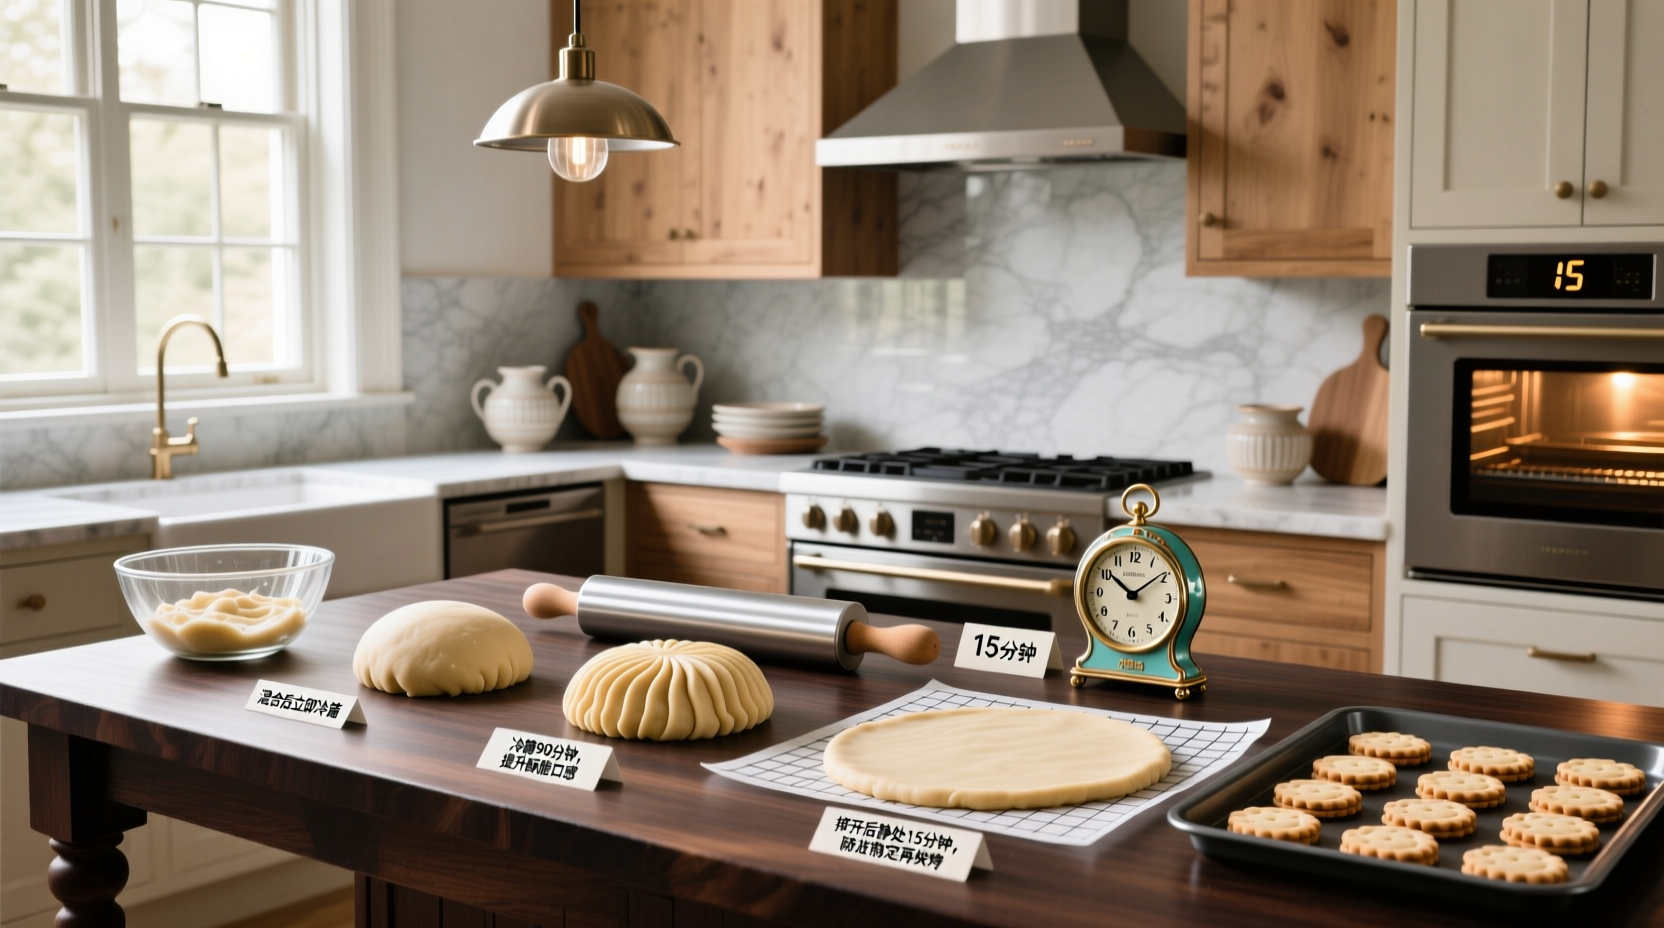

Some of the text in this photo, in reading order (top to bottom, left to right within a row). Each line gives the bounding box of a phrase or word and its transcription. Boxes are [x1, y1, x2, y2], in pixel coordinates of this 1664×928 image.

[1554, 259, 1585, 291] 15
[1114, 555, 1122, 567] 11
[1130, 551, 1141, 564] 12
[1101, 568, 1112, 581] 10
[1112, 620, 1119, 631] 7
[1146, 623, 1153, 635] 5
[1127, 626, 1136, 638] 6
[974, 633, 1037, 664] 15分钟
